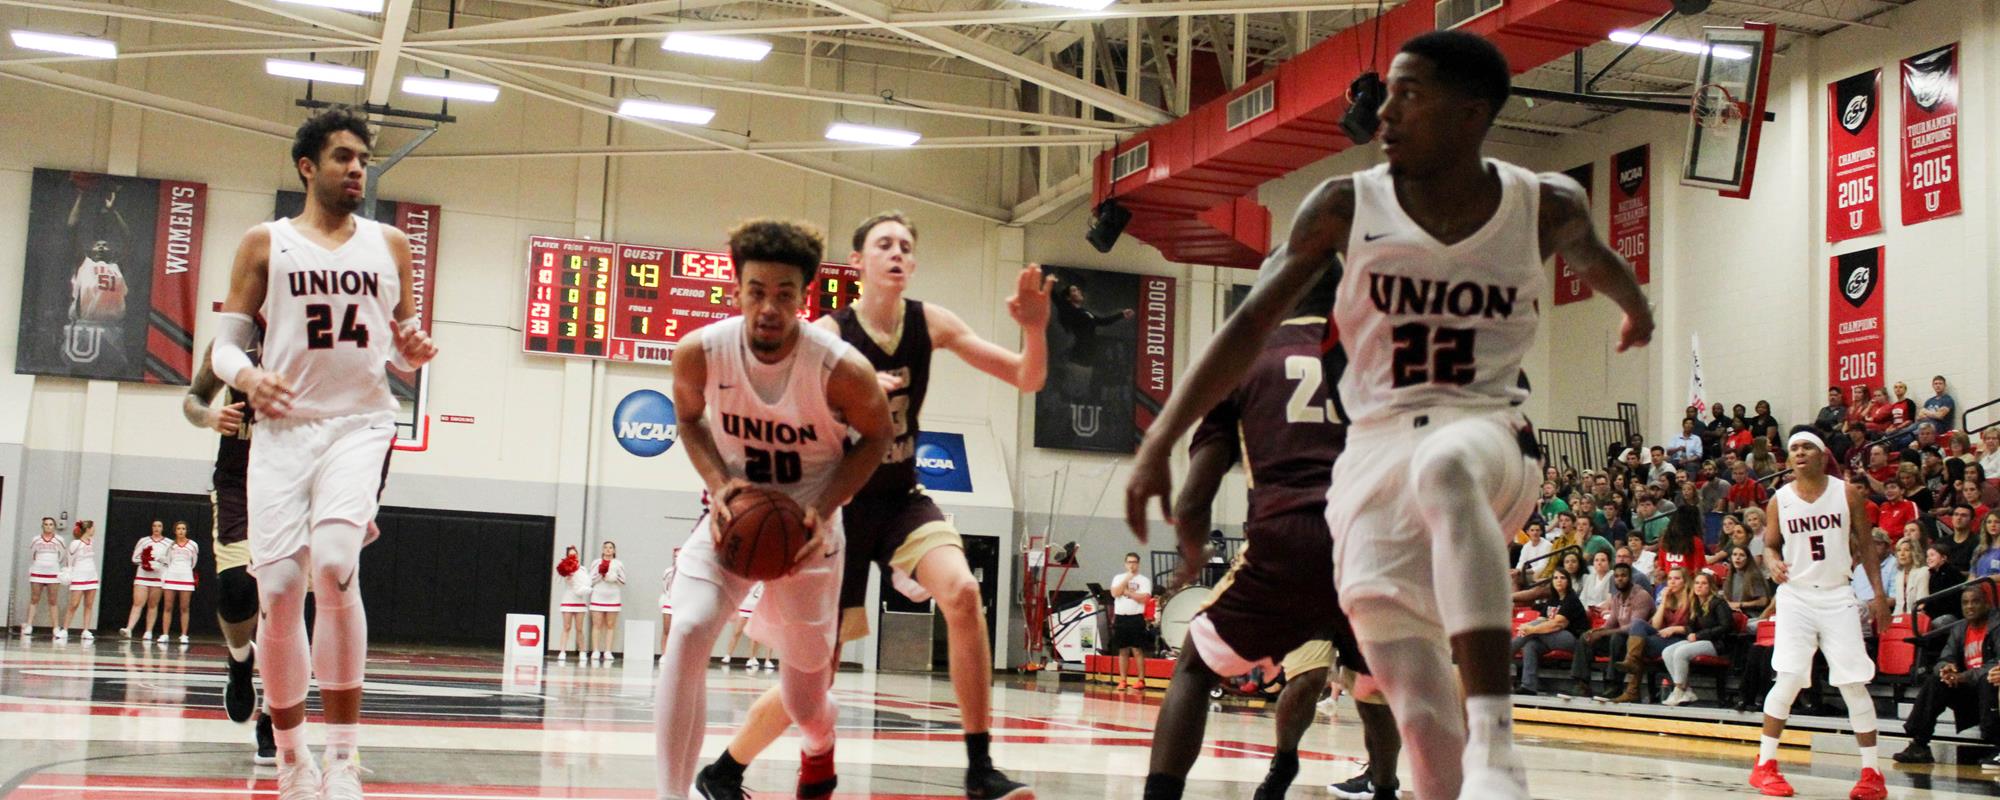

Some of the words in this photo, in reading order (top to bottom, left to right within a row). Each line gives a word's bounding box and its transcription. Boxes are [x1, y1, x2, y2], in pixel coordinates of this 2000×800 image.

[1907, 112, 1957, 137] TOURNAMENT
[1911, 128, 1952, 150] CHAMPIONS
[1838, 146, 1875, 167] CHAMPIONS
[1620, 167, 1643, 184] NCAA
[1913, 155, 1952, 190] 2015
[1838, 176, 1874, 209] 2015
[1925, 190, 1940, 212] U
[1849, 209, 1864, 230] U
[165, 186, 195, 275] WOMEN'S
[533, 241, 559, 249] PLAYER
[623, 248, 664, 261] GUEST
[1618, 232, 1644, 258] 2016
[544, 252, 554, 267] 0
[571, 255, 581, 270] 0
[598, 258, 608, 272] 3
[682, 253, 732, 280] 15:32
[98, 274, 116, 292] 51
[288, 270, 379, 298] UNION
[574, 272, 580, 286] 1
[596, 274, 608, 289] 2
[631, 264, 660, 288] 43
[828, 278, 838, 293] 0
[537, 286, 552, 300] 11
[568, 288, 579, 304] 0
[670, 288, 706, 298] PERIOD
[710, 286, 723, 304] 2
[832, 296, 837, 309] 1
[1369, 272, 1518, 318] UNION
[531, 302, 550, 318] 23
[572, 306, 578, 320] 1
[628, 304, 653, 313] FOULS
[672, 308, 690, 316] TIME
[690, 310, 710, 318] OUTS
[1146, 280, 1166, 356] BULLDOG
[305, 304, 370, 350] 24
[530, 320, 549, 334] 33
[566, 322, 577, 337] 3
[593, 324, 604, 339] 3
[641, 316, 648, 334] 1
[665, 318, 678, 336] 2
[1838, 317, 1878, 335] CHAMPIONS
[1392, 322, 1476, 388] 22
[1151, 360, 1164, 392] LADY
[1840, 352, 1877, 382] 2016
[1284, 355, 1343, 424] 2
[618, 422, 677, 442] NCAA
[721, 412, 818, 446] UNION
[744, 446, 803, 484] 20
[916, 457, 956, 470] NCAA
[1788, 513, 1842, 534] UNION
[1810, 534, 1826, 562] 5
